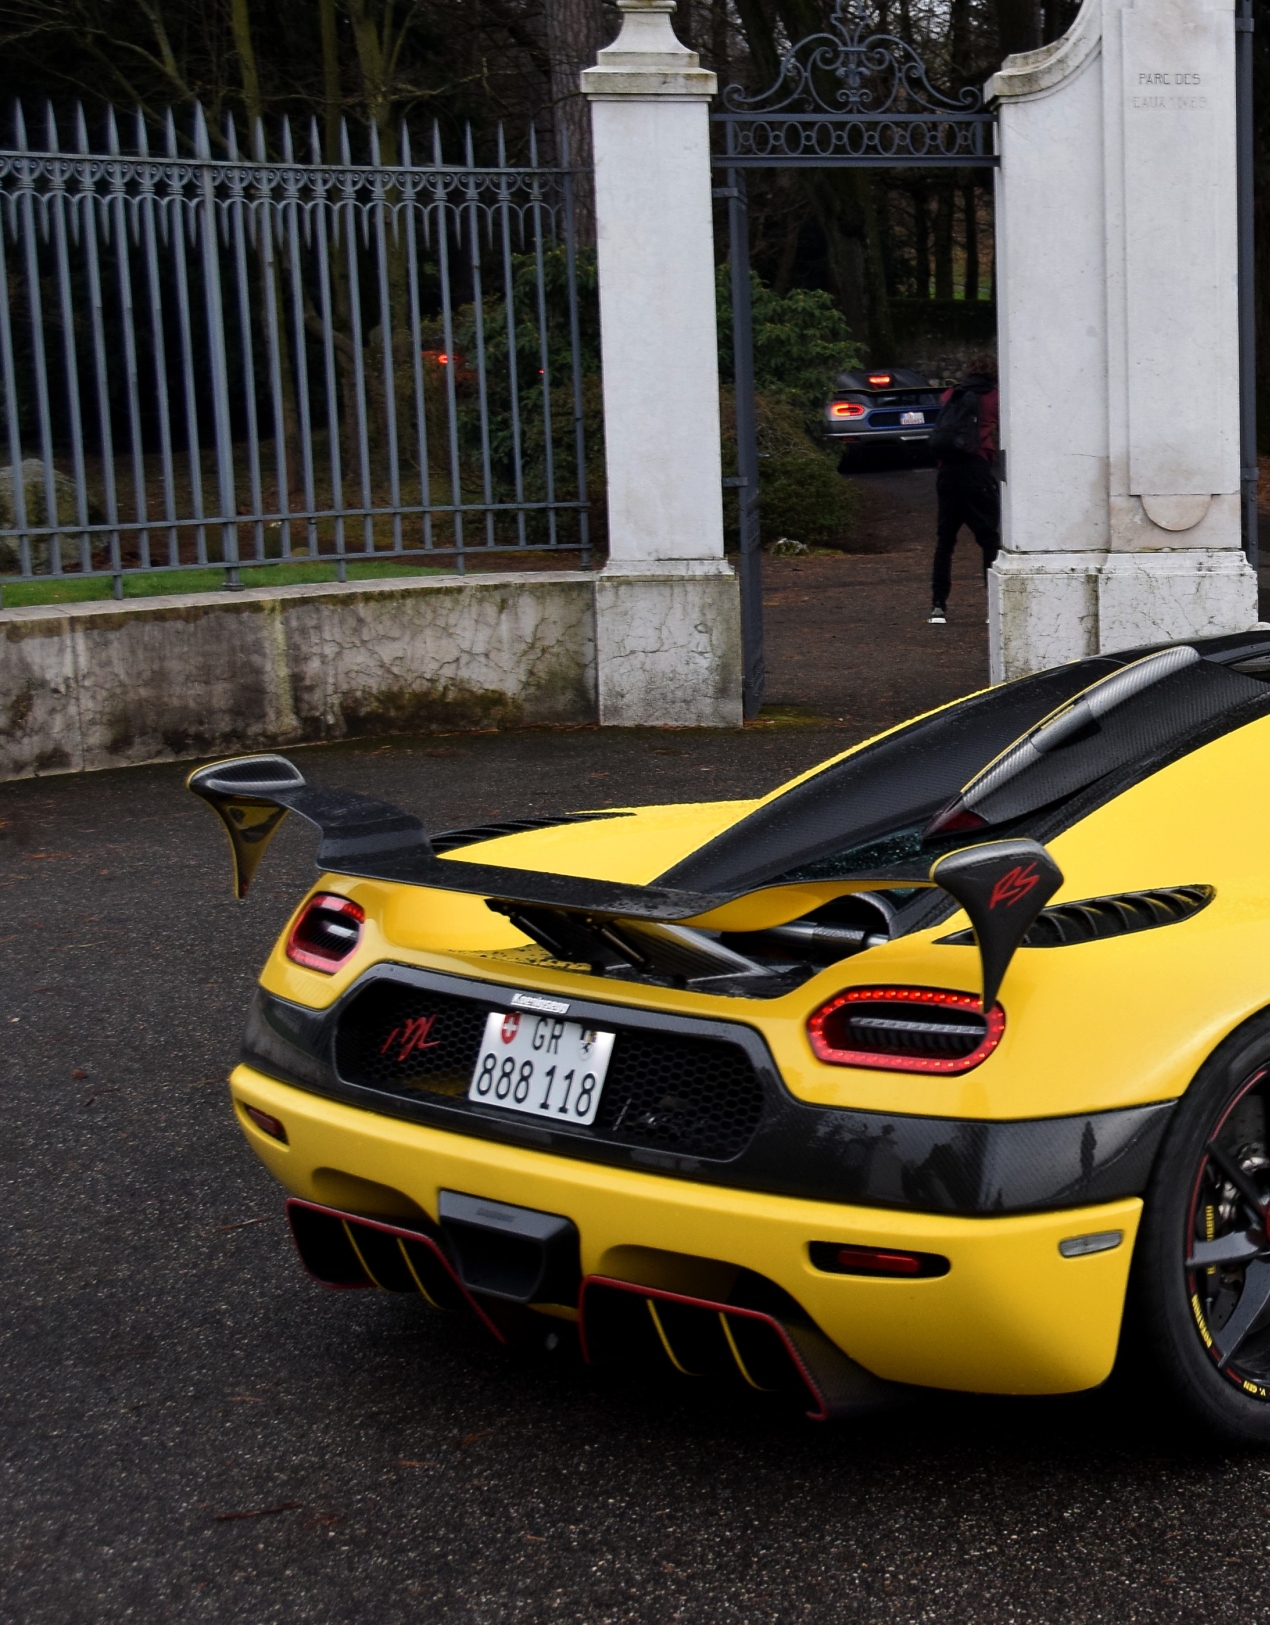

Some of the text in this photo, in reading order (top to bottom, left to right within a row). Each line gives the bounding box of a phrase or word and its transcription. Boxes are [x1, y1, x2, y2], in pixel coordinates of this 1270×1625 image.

[1138, 73, 1202, 85] PARC DES
[988, 860, 1040, 910] RS
[532, 1017, 567, 1055] GR
[476, 1052, 596, 1117] 888 118
